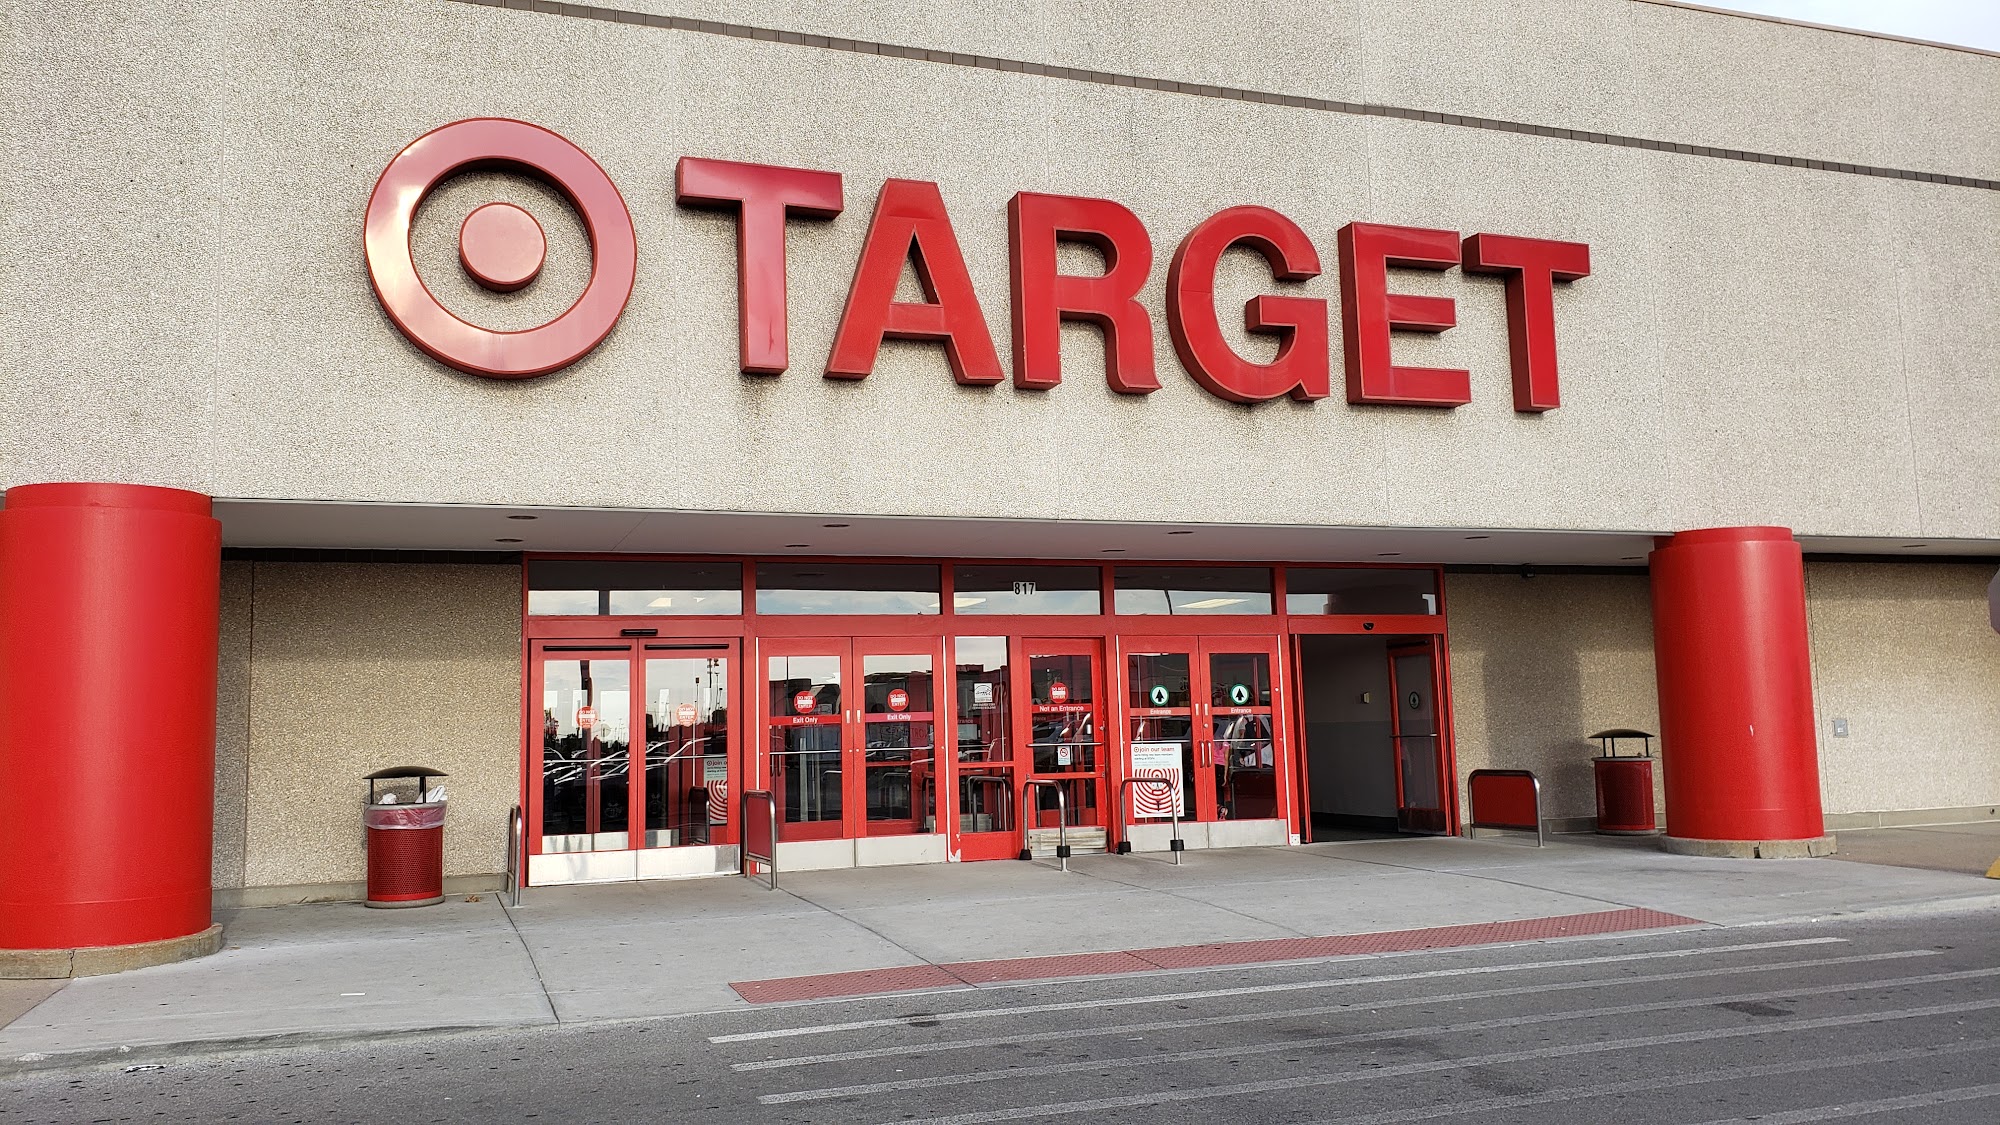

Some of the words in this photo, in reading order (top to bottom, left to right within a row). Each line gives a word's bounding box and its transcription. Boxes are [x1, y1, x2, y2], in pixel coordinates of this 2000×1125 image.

[675, 156, 1590, 413] TARGET
[1014, 582, 1034, 595] 817
[805, 715, 818, 724] Only
[898, 713, 911, 721] Only
